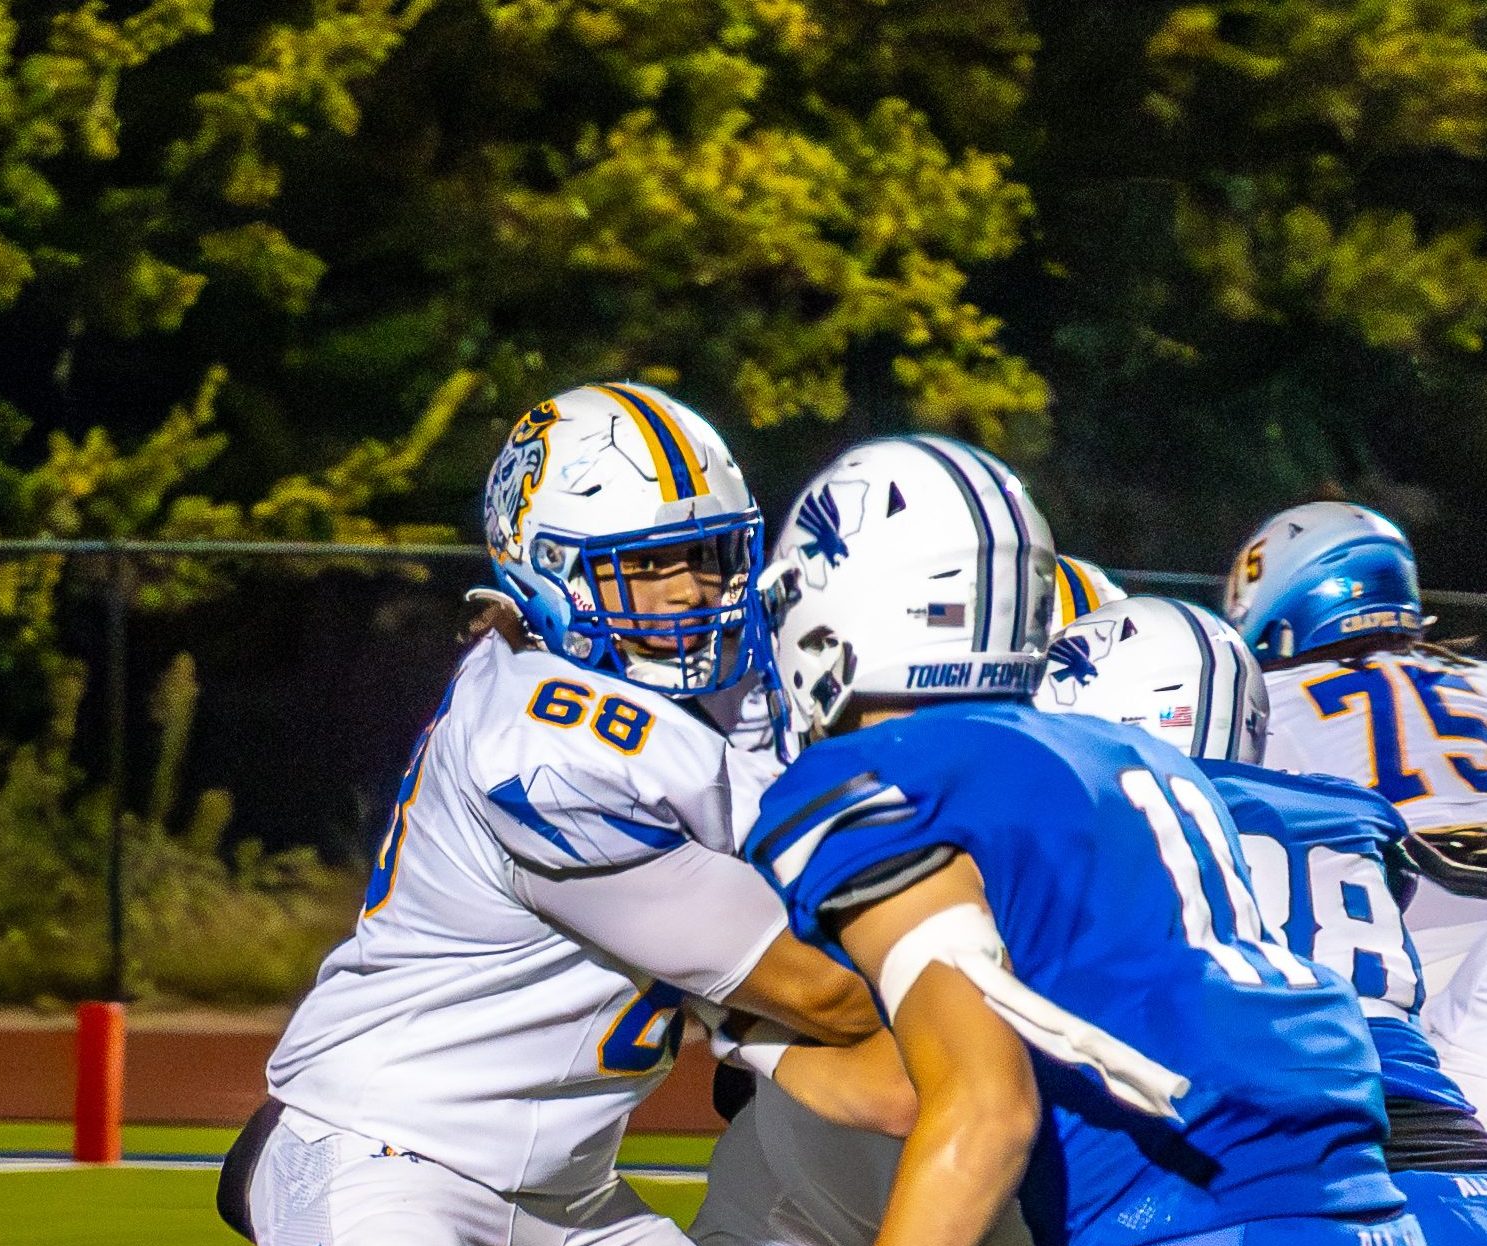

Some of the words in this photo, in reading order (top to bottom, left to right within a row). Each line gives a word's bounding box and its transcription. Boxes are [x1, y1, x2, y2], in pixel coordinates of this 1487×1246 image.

[907, 662, 972, 689] TOUGH
[525, 677, 657, 757] 68
[1119, 767, 1322, 987] 11
